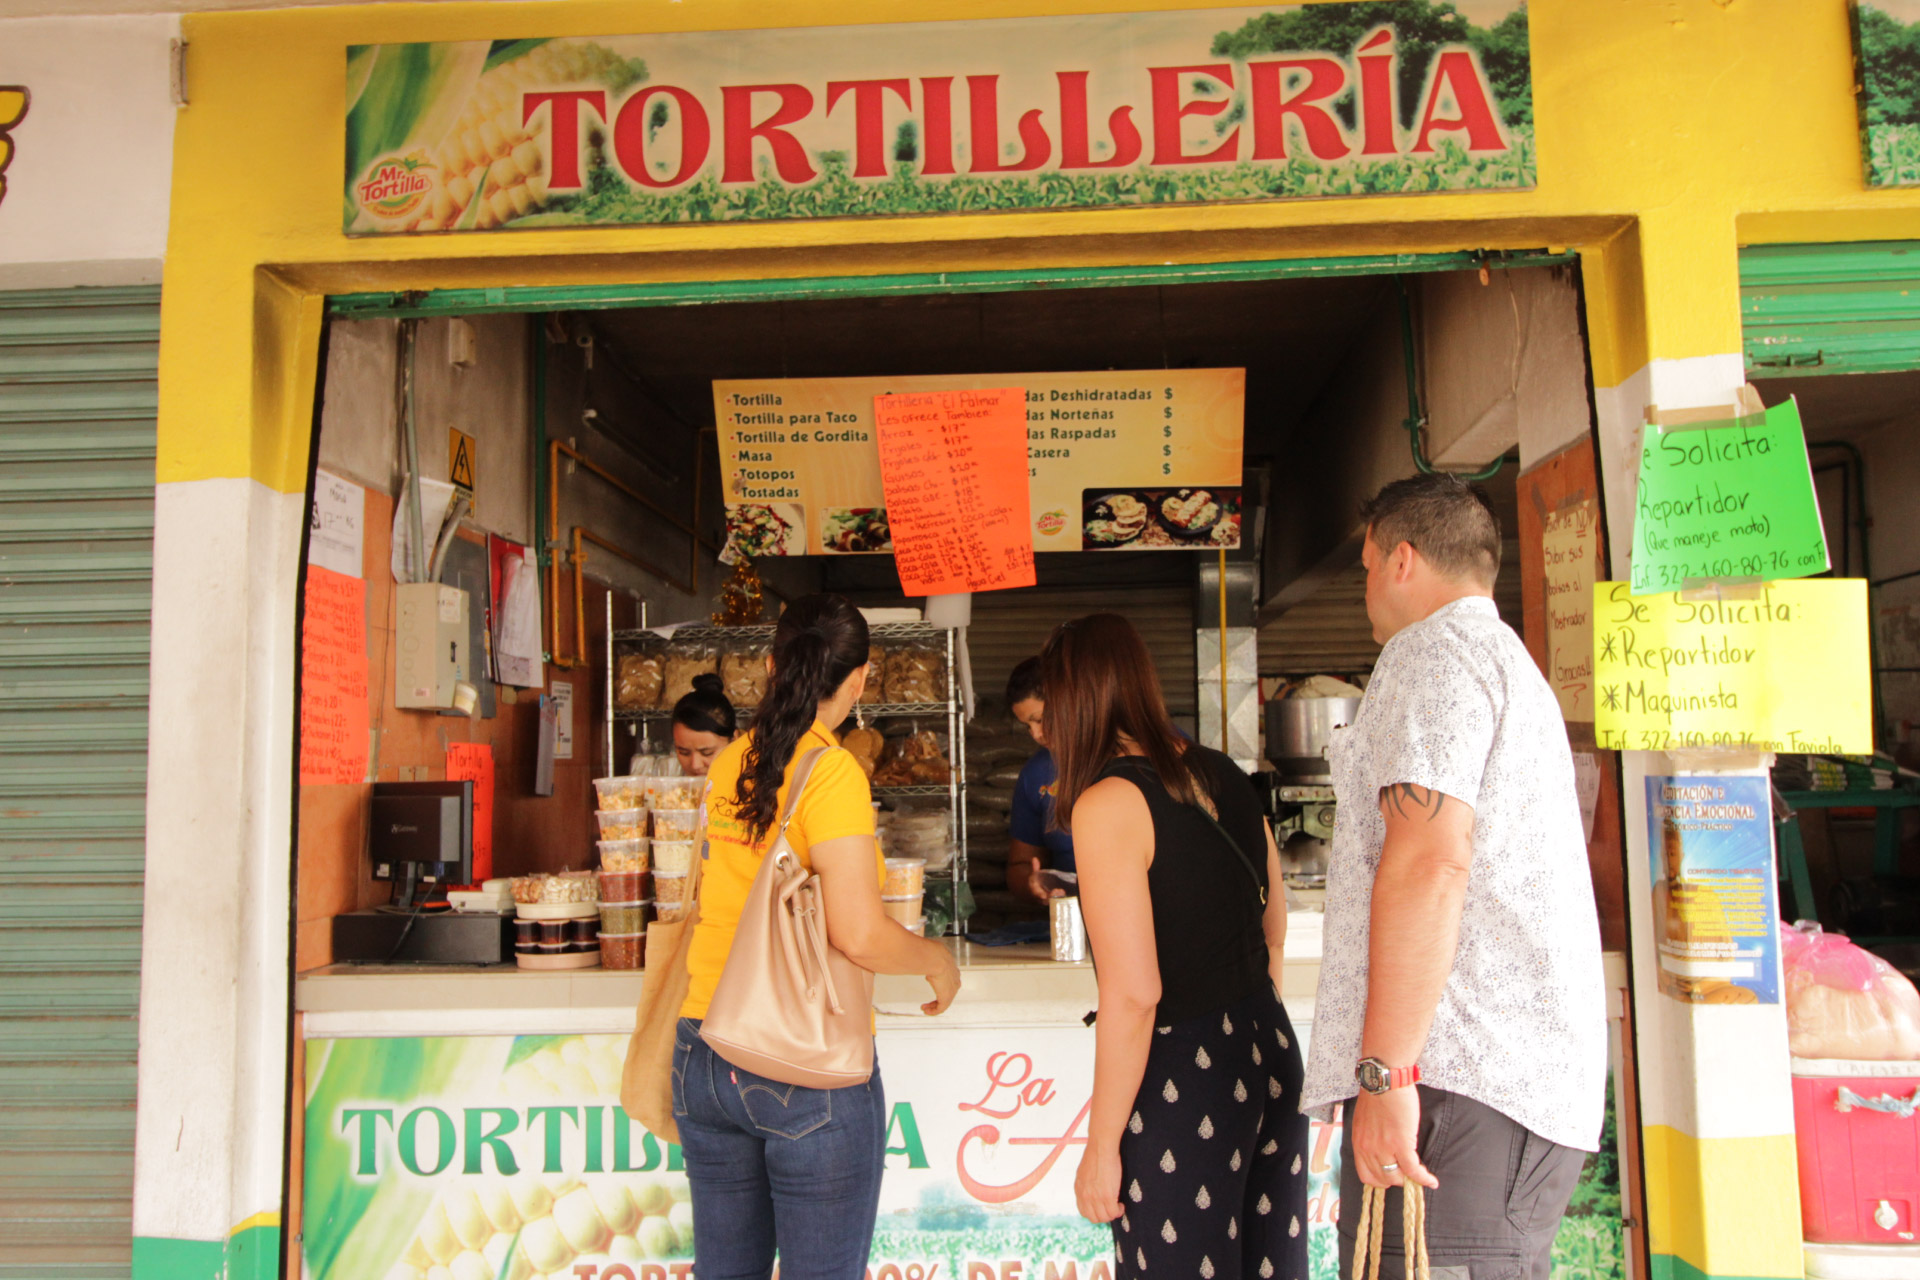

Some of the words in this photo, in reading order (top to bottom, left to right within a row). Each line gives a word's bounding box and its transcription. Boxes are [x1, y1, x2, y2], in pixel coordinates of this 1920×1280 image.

[522, 30, 1508, 188] TORTILLERÍA
[381, 166, 406, 182] Mr.
[361, 174, 424, 202] Tortilla
[733, 393, 783, 406] Tortilla
[1051, 388, 1152, 402] Deshidratadas
[1164, 387, 1173, 400] $
[734, 412, 784, 425] Tortilla
[789, 414, 821, 426] para
[826, 411, 858, 424] Taco
[1051, 407, 1114, 420] Norteñas
[1163, 406, 1173, 419] $
[736, 431, 785, 444] Tortilla
[791, 430, 808, 443] de
[814, 430, 869, 443] Gordita
[1051, 427, 1117, 441] Raspadas
[1163, 425, 1172, 438] $
[738, 450, 773, 462] Masa
[1162, 444, 1171, 457] $
[739, 468, 795, 482] Totopos
[1162, 463, 1171, 475] $
[741, 487, 799, 498] Tostadas
[1638, 479, 1750, 529] Repartidor
[1673, 531, 1721, 548] maneje
[1730, 515, 1770, 538] moto)
[1569, 545, 1583, 563] sus
[1609, 583, 1650, 623] Se
[1617, 626, 1756, 677] Repartidor
[1625, 680, 1738, 725] Maquinista
[1694, 802, 1755, 819] EMOCIONAL
[958, 1051, 1056, 1119] La
